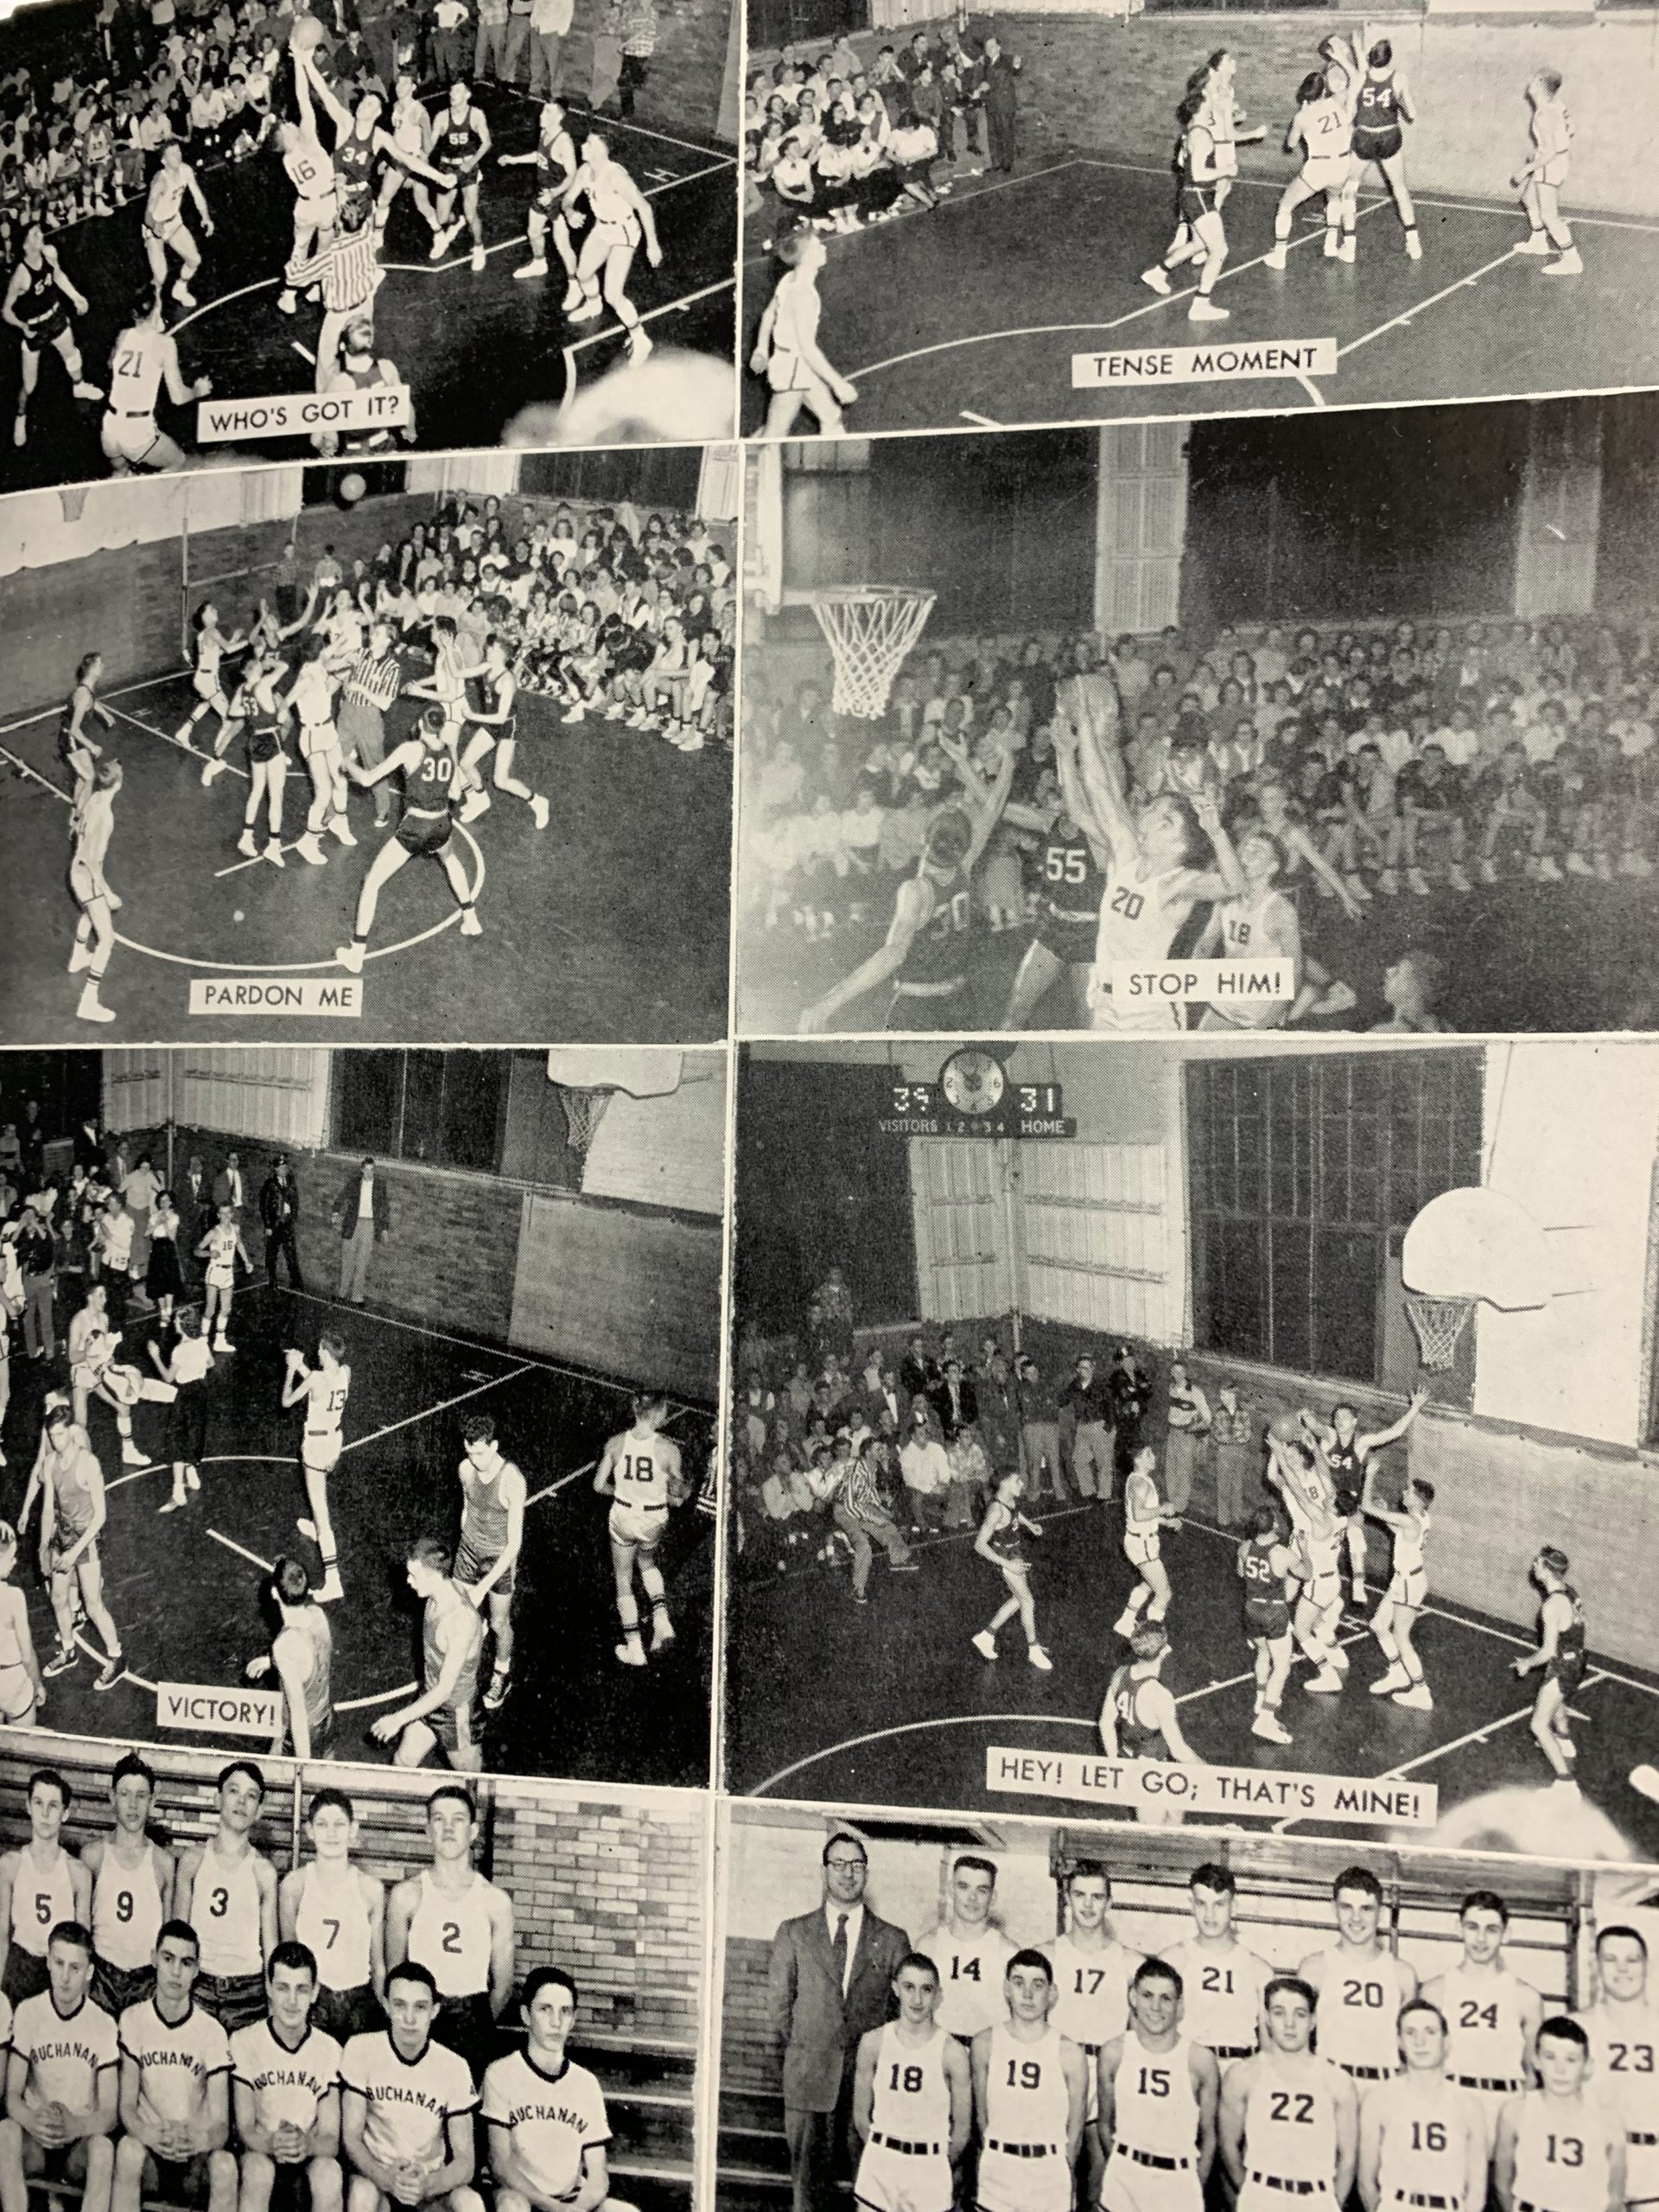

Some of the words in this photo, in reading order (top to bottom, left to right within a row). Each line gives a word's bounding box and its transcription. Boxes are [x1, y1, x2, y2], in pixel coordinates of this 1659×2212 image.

[1362, 86, 1393, 108] 54
[1318, 111, 1343, 135] 21
[448, 132, 469, 145] 55
[342, 148, 368, 166] 34
[291, 160, 317, 185] 16
[118, 350, 143, 378] 21
[1093, 353, 1173, 378] TENSE
[1191, 347, 1318, 373] MOMENT
[210, 406, 288, 432] WHO'S
[302, 400, 353, 423] GOT
[368, 395, 399, 416] IT?
[421, 757, 453, 784] 30
[1046, 847, 1086, 884] 55
[1110, 886, 1146, 921] 20
[1228, 919, 1252, 946] 18
[205, 984, 302, 1006] PARDON
[319, 987, 353, 1007] ME
[1129, 973, 1198, 996] STOP
[1217, 971, 1281, 994] HIM!
[1020, 1087, 1053, 1112] 31
[878, 1119, 938, 1133] VISITORS
[1020, 1119, 1066, 1134] HOME
[326, 1389, 346, 1412] 13
[623, 1454, 654, 1483] 18
[1245, 1557, 1271, 1584] 52
[168, 1695, 275, 1726] VICTORY!
[1000, 1757, 1064, 1784] HEY!
[1081, 1765, 1123, 1789] LET
[1141, 1770, 1199, 1801] GO;
[1217, 1776, 1315, 1808] THAT'S
[1333, 1788, 1421, 1818] MINE!
[35, 1893, 52, 1925] 5
[116, 1891, 134, 1923] 9
[209, 1887, 229, 1917] 3
[322, 1918, 340, 1949] 7
[442, 1922, 463, 1955] 2
[950, 1955, 982, 1982] 14
[1073, 1967, 1106, 1995] 17
[1201, 1966, 1235, 1994] 21
[1342, 1979, 1384, 2009] 20
[1459, 1999, 1498, 2031] 24
[140, 2051, 207, 2075] UCHANAN
[1608, 2043, 1656, 2073] 23
[889, 2063, 924, 2093] 18
[1006, 2058, 1042, 2090] 19
[1137, 2067, 1171, 2098] 15
[1270, 2091, 1315, 2124] 22
[1410, 2120, 1447, 2152] 16
[1545, 2133, 1585, 2167] 13
